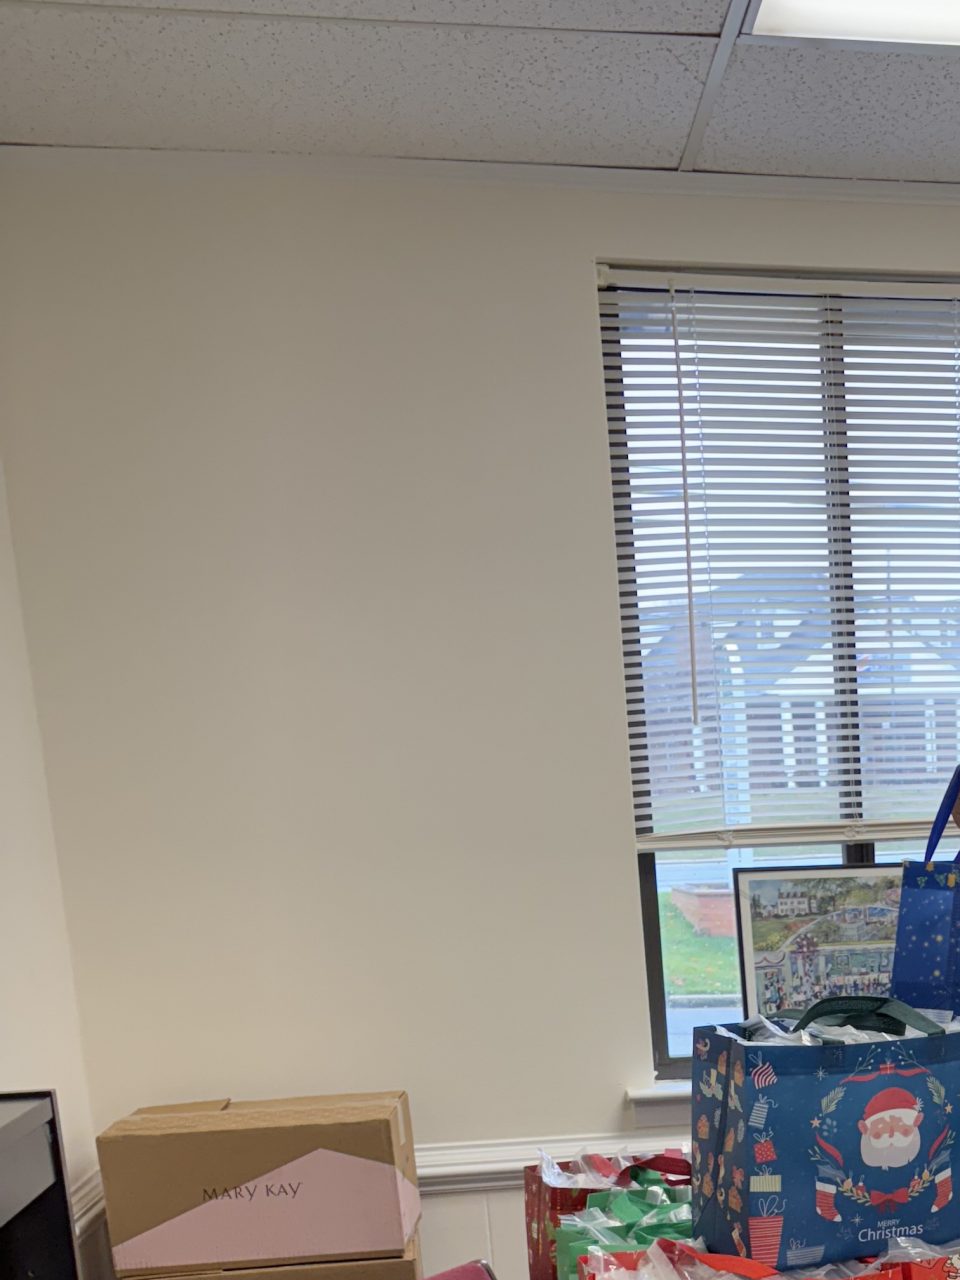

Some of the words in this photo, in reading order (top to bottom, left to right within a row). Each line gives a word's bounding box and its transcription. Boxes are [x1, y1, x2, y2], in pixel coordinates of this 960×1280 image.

[202, 1184, 258, 1201] MARY
[265, 1181, 303, 1199] KAY
[877, 1219, 901, 1228] MERRY
[858, 1224, 924, 1242] Christmas
